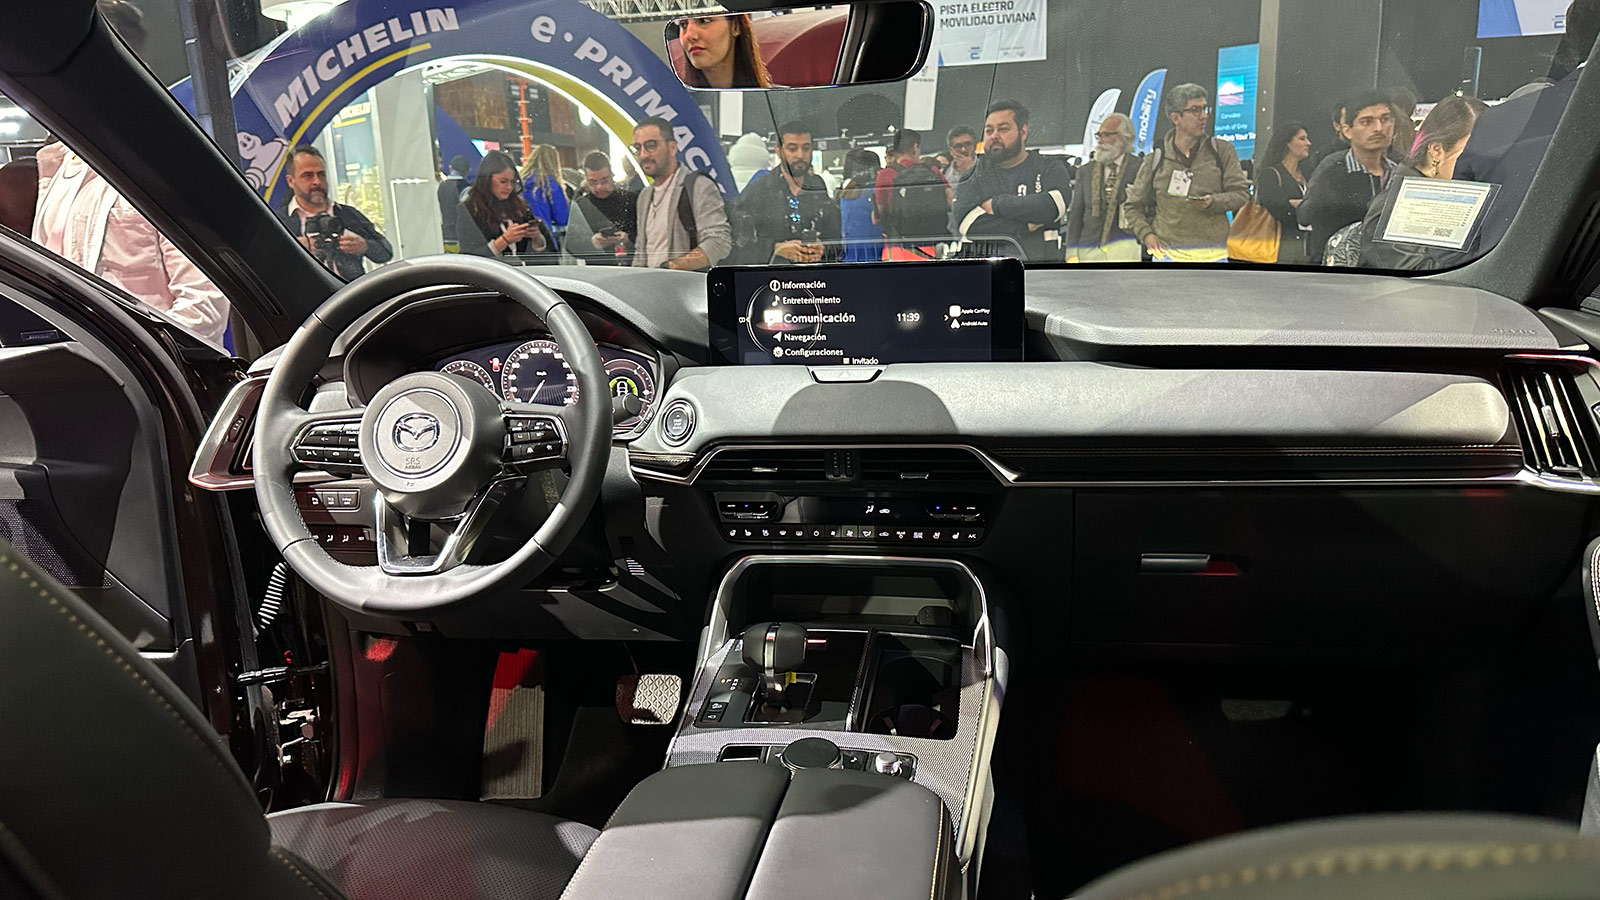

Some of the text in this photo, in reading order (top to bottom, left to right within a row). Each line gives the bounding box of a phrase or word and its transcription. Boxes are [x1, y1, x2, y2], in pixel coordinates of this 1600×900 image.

[939, 0, 1014, 16] PISTA ELECTRO
[940, 12, 1037, 28] MOVILIDAD LIVIANA
[274, 8, 460, 128] MICHELIN
[782, 281, 826, 289] Información
[782, 296, 841, 305] Entretenimiento
[783, 312, 856, 324] Comunicación
[896, 312, 920, 322] 11:39
[784, 332, 827, 343] Navegación
[784, 347, 844, 358] Configuraciones
[852, 356, 879, 365] Invitado
[405, 457, 421, 465] SRS
